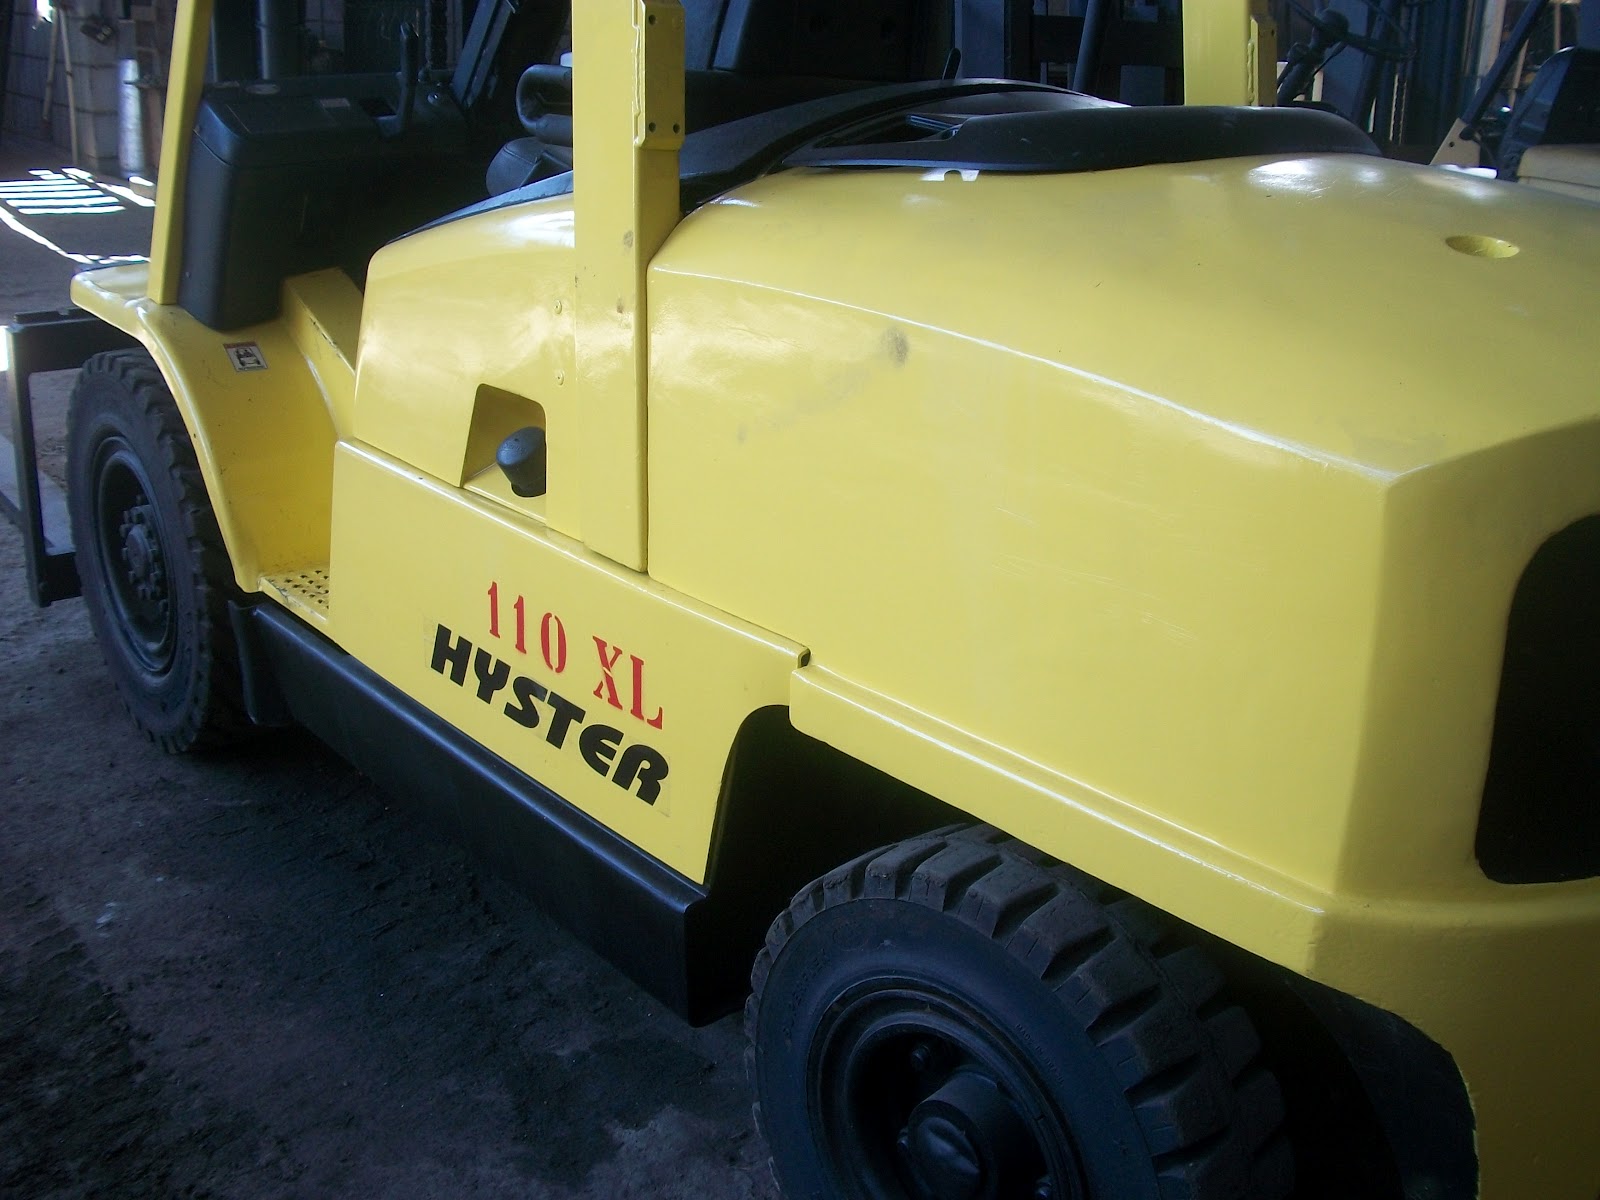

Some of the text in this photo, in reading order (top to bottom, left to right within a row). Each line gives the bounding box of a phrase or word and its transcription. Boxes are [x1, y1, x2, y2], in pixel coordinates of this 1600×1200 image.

[430, 623, 669, 806] HYSTER
[488, 581, 663, 730] 110 XL
